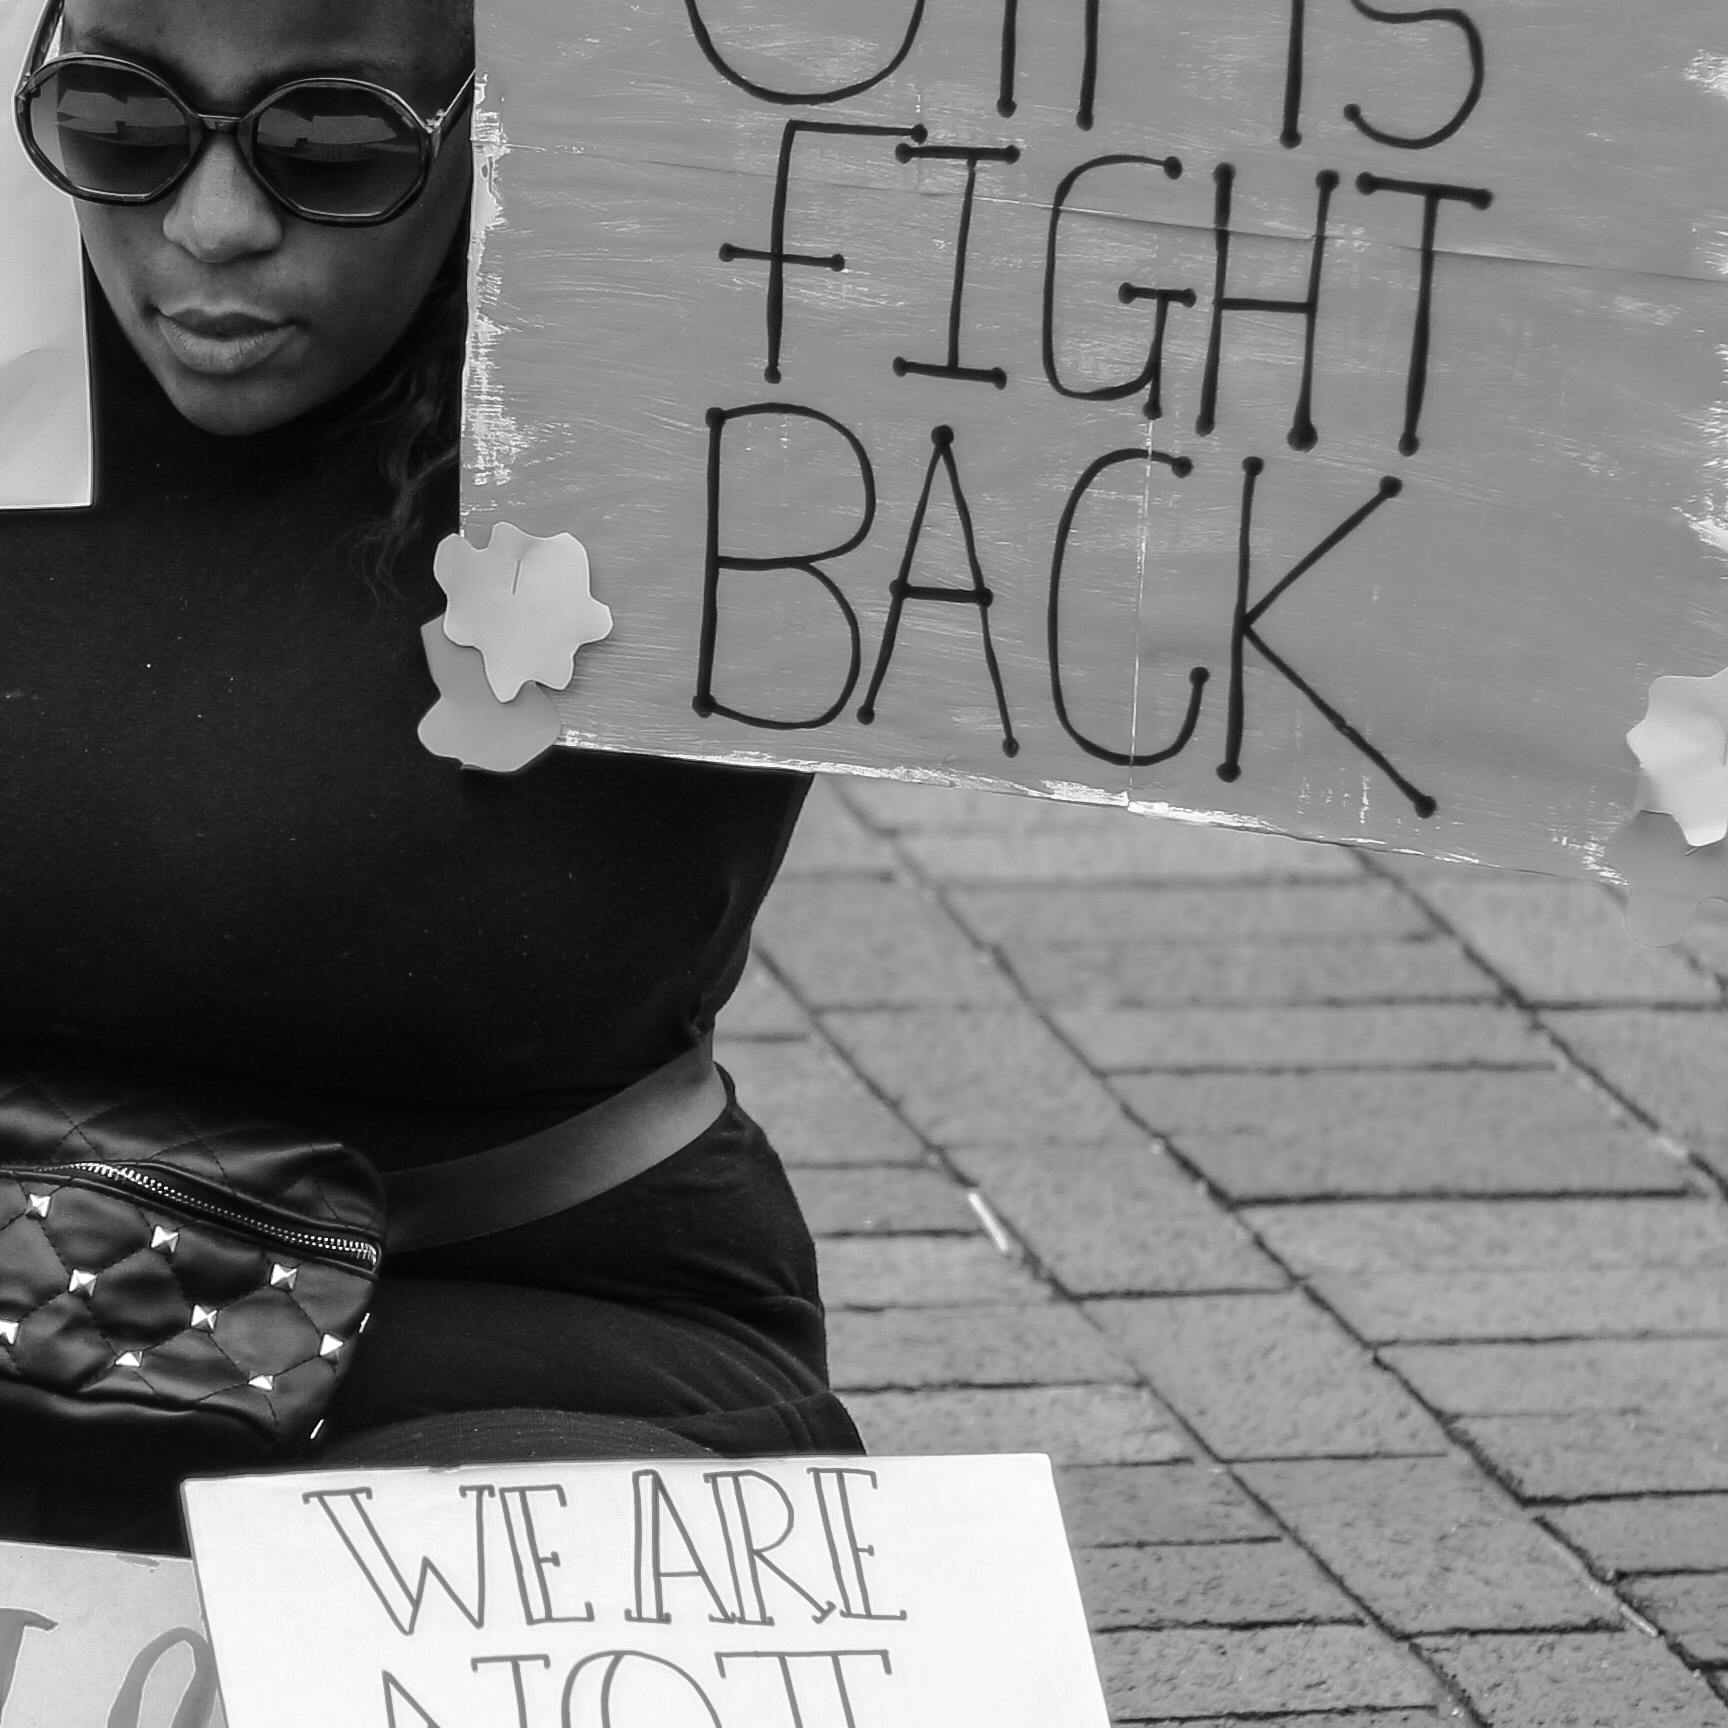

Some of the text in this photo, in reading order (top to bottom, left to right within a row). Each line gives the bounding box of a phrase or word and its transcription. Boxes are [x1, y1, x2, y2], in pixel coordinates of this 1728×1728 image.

[718, 119, 1494, 456] FIGHT
[693, 402, 1438, 817] BACK
[302, 1465, 909, 1637] WE ARE
